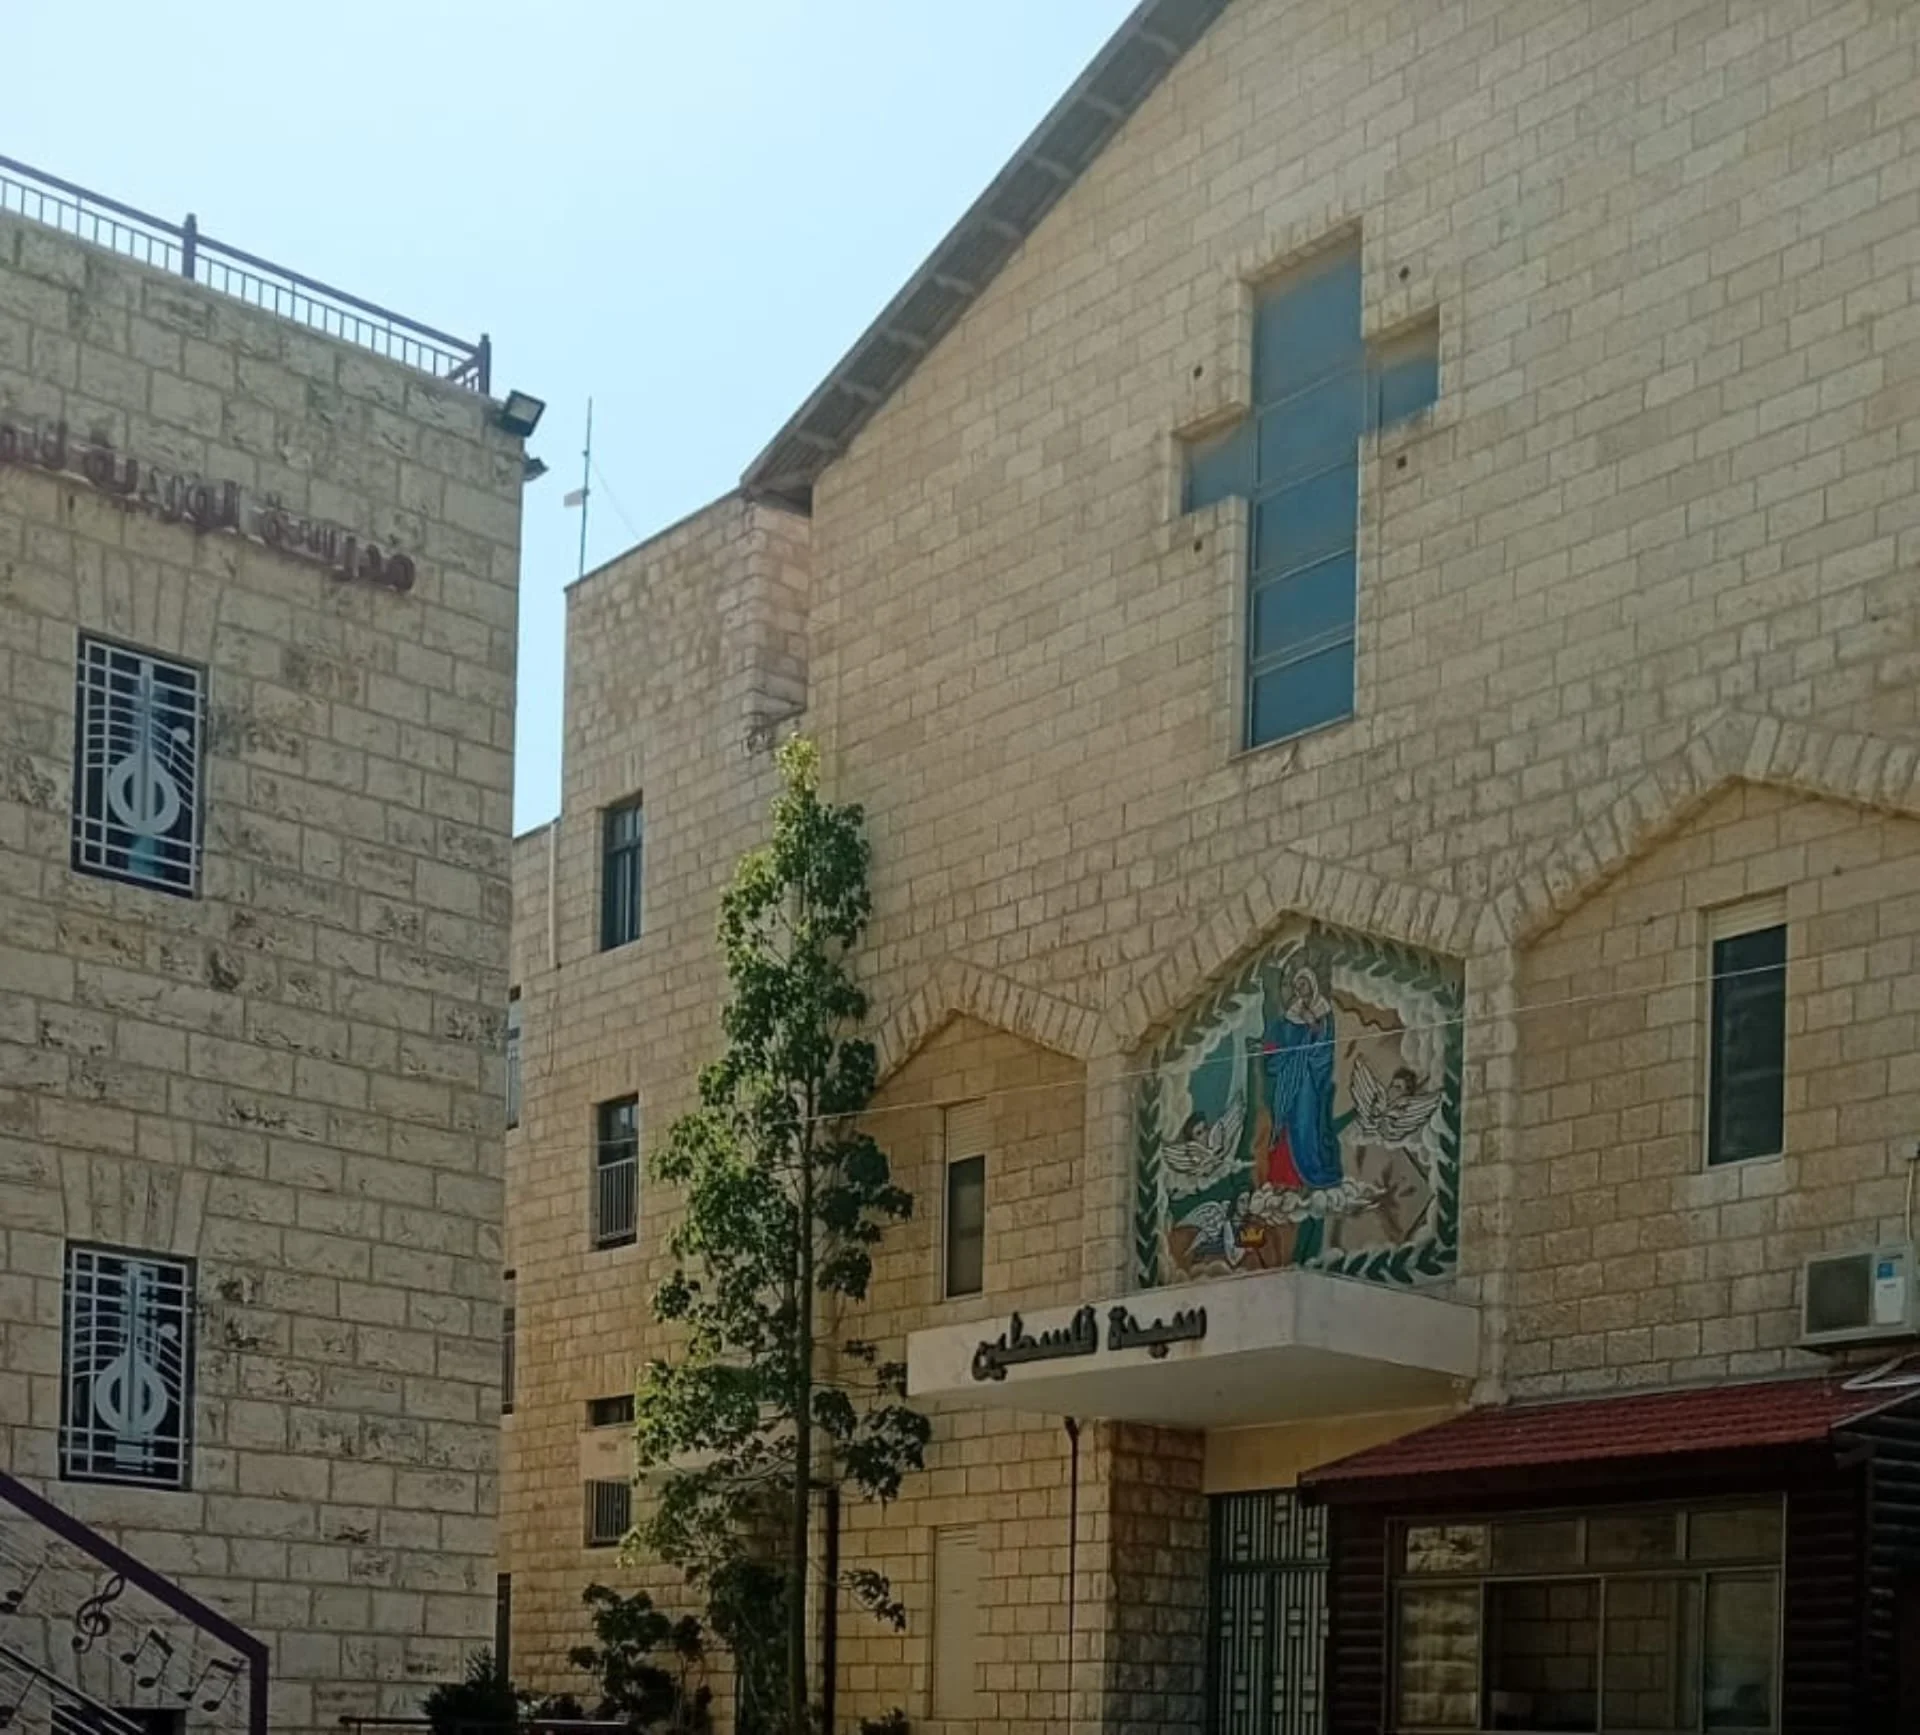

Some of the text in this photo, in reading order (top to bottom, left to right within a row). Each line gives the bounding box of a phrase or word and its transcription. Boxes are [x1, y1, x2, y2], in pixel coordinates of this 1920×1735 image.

[257, 491, 416, 594] مدرسة
[971, 1304, 1208, 1382] سيدة فلسطين
